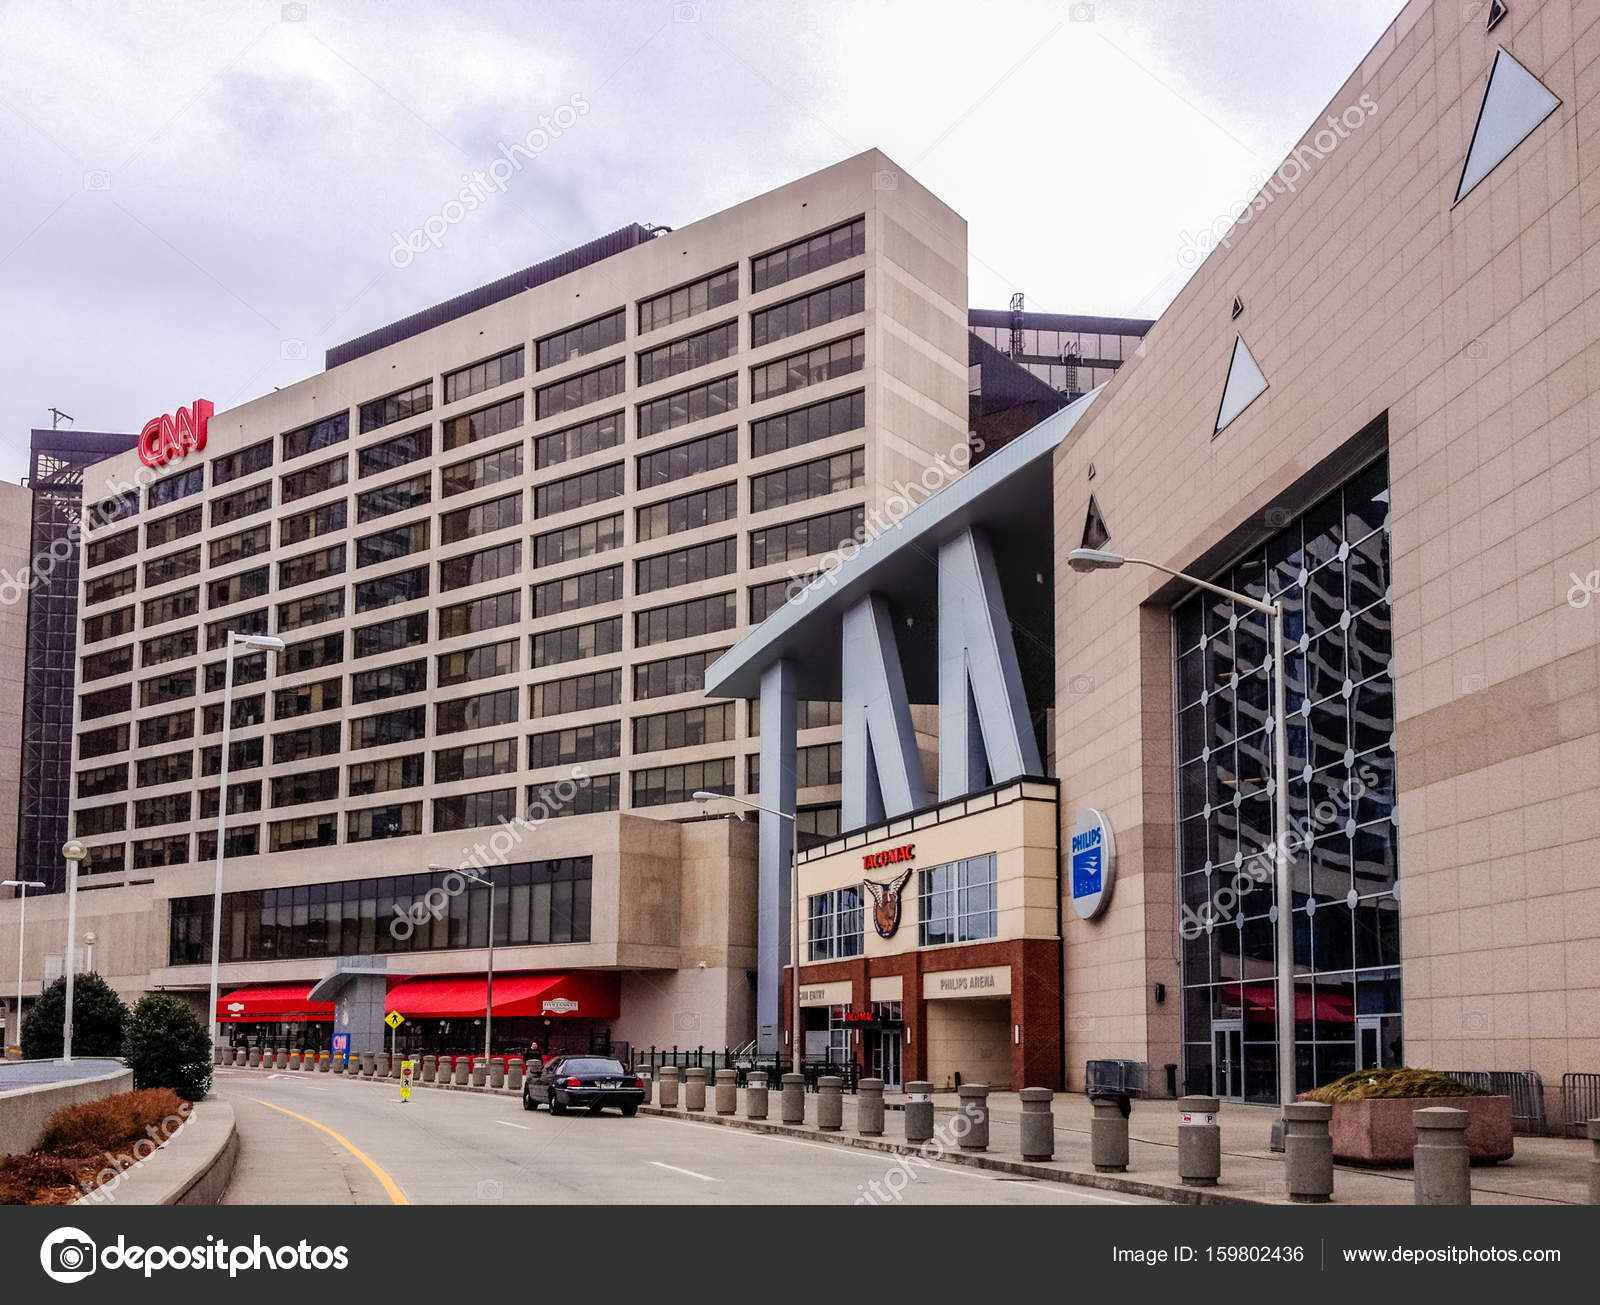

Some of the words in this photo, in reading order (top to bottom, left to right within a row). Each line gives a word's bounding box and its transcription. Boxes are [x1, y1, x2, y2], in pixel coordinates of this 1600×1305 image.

[138, 398, 213, 468] CNN
[1072, 827, 1102, 854] PHILIPS
[940, 976, 969, 991] PHILIPS
[969, 975, 995, 989] ARENA
